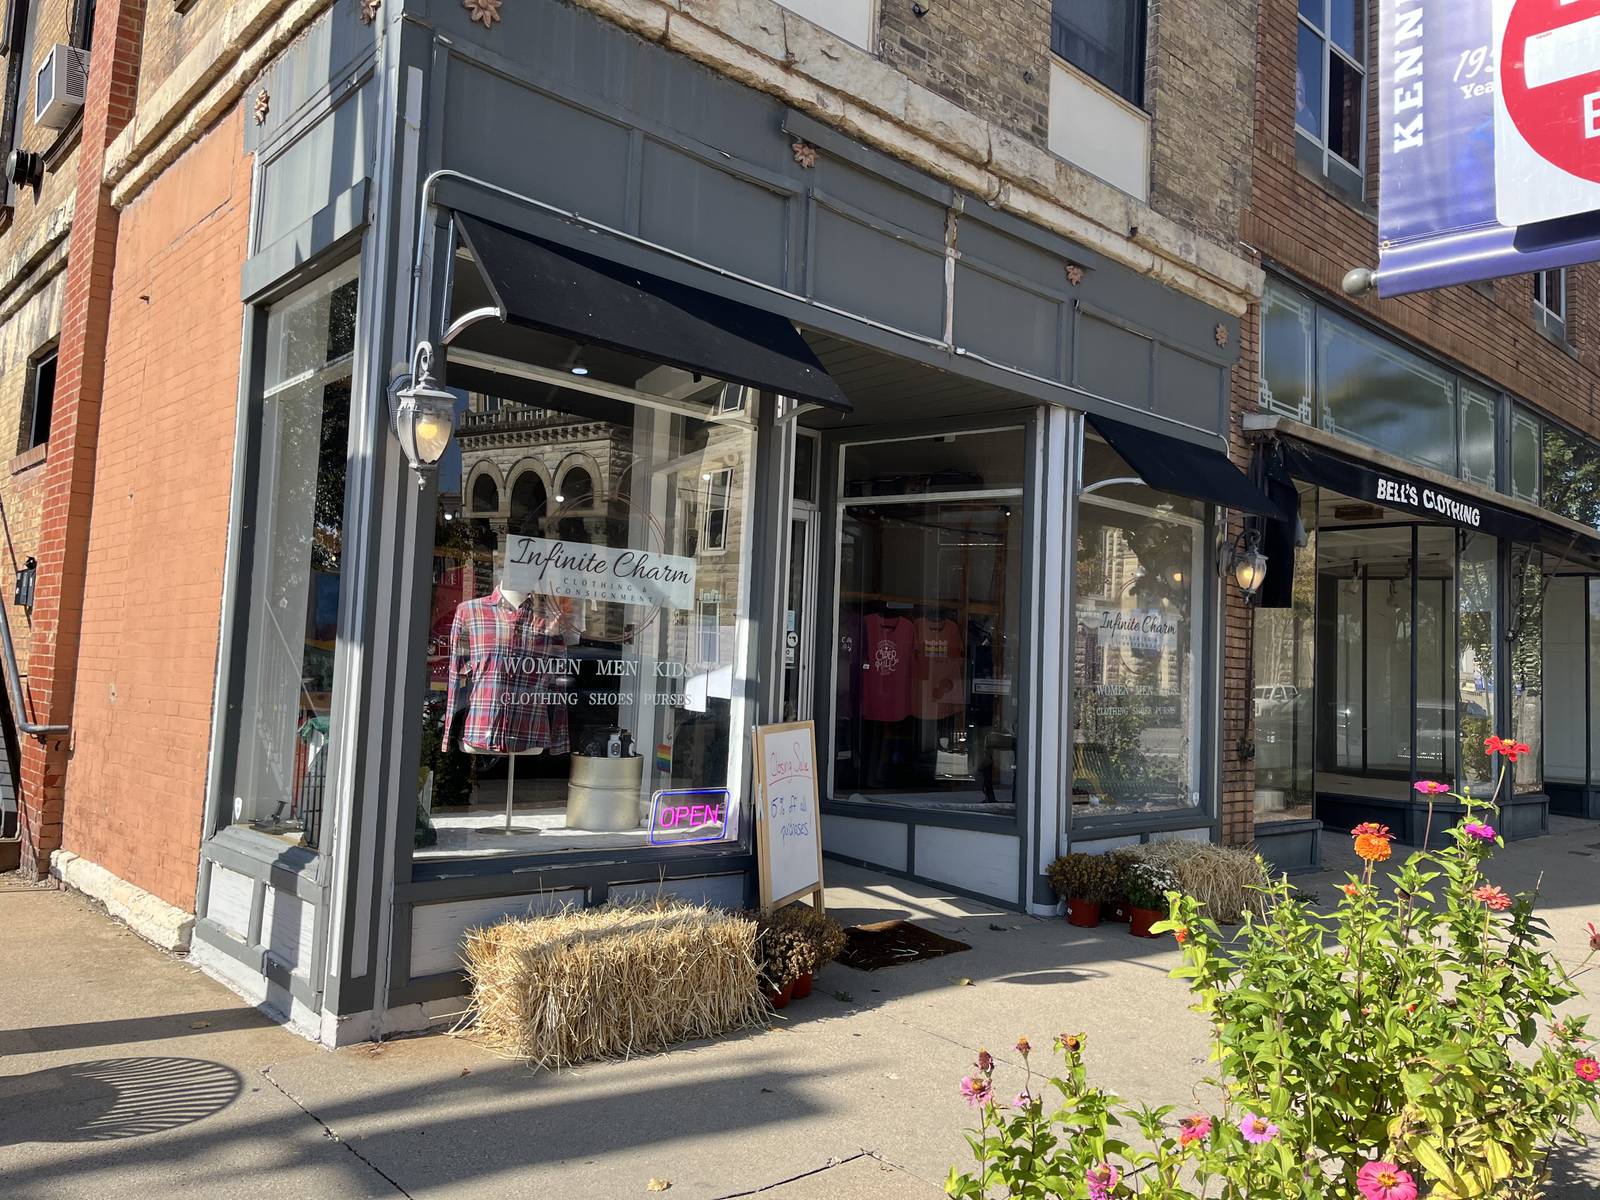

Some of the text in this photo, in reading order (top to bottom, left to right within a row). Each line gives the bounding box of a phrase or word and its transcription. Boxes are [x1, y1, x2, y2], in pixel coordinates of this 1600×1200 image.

[1394, 0, 1423, 153] KENN
[1377, 479, 1480, 527] BELL'S CLOTHING
[510, 538, 692, 584] Infinite Charm
[555, 587, 654, 602] CONSIGNMENT
[563, 577, 633, 593] CLOTHING
[1100, 611, 1176, 638] Infinite Charm
[502, 656, 694, 678] WOMEN MEN KIDS
[501, 690, 692, 706] CLOTHING SHOES PURSES
[1097, 685, 1129, 696] WOMEN
[660, 804, 719, 828] OPEN
